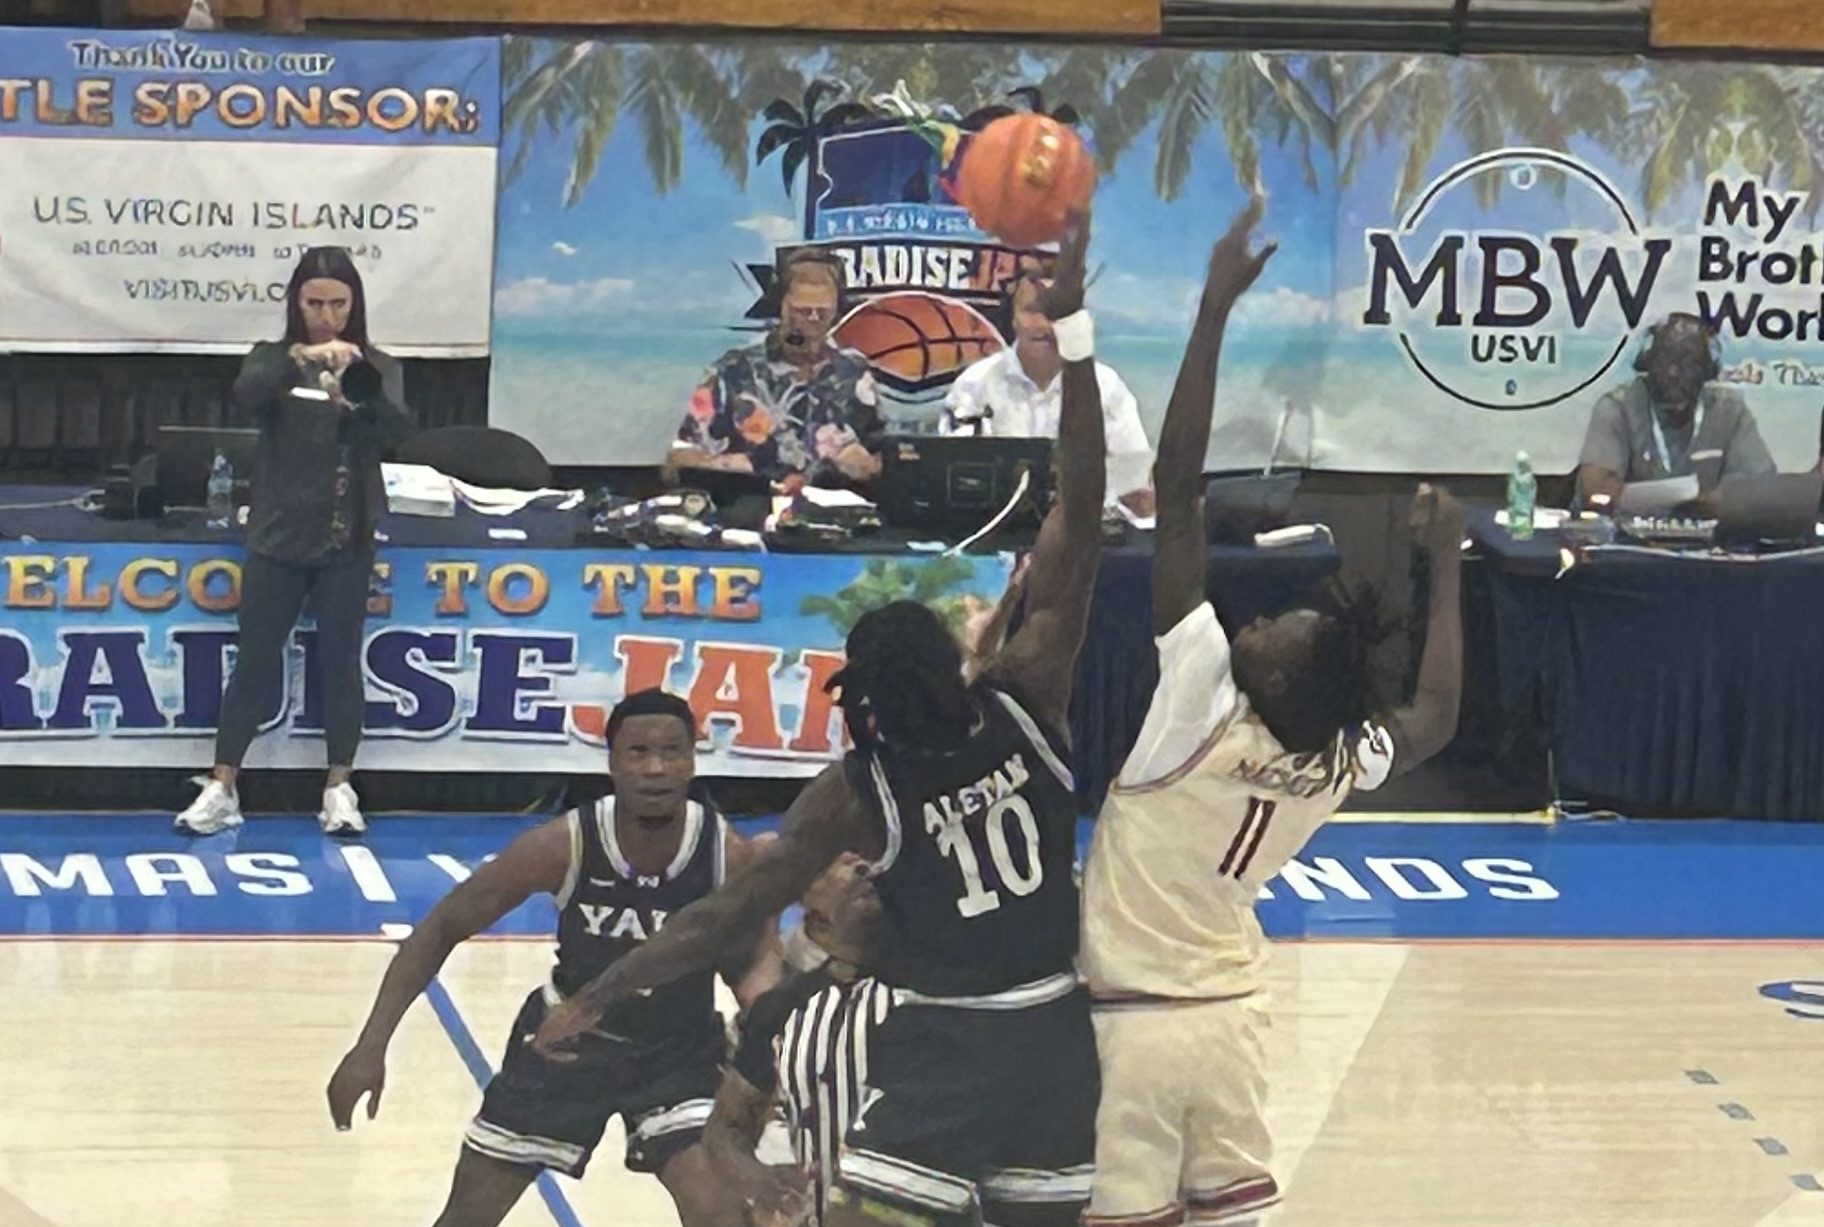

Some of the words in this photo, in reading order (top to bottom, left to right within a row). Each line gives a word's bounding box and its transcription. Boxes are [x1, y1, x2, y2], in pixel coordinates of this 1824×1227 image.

[172, 43, 228, 72] You
[236, 49, 270, 73] to
[277, 52, 335, 76] our
[104, 199, 234, 227] VIRGIN
[1703, 178, 1801, 243] My
[1363, 232, 1672, 329] MBW
[1698, 235, 1824, 287] Brot
[1471, 334, 1557, 363] USVI
[425, 560, 549, 617] TO
[583, 563, 761, 621] THE
[937, 794, 1043, 918] 10
[1217, 797, 1277, 881] 11
[1257, 856, 1561, 900] NDS
